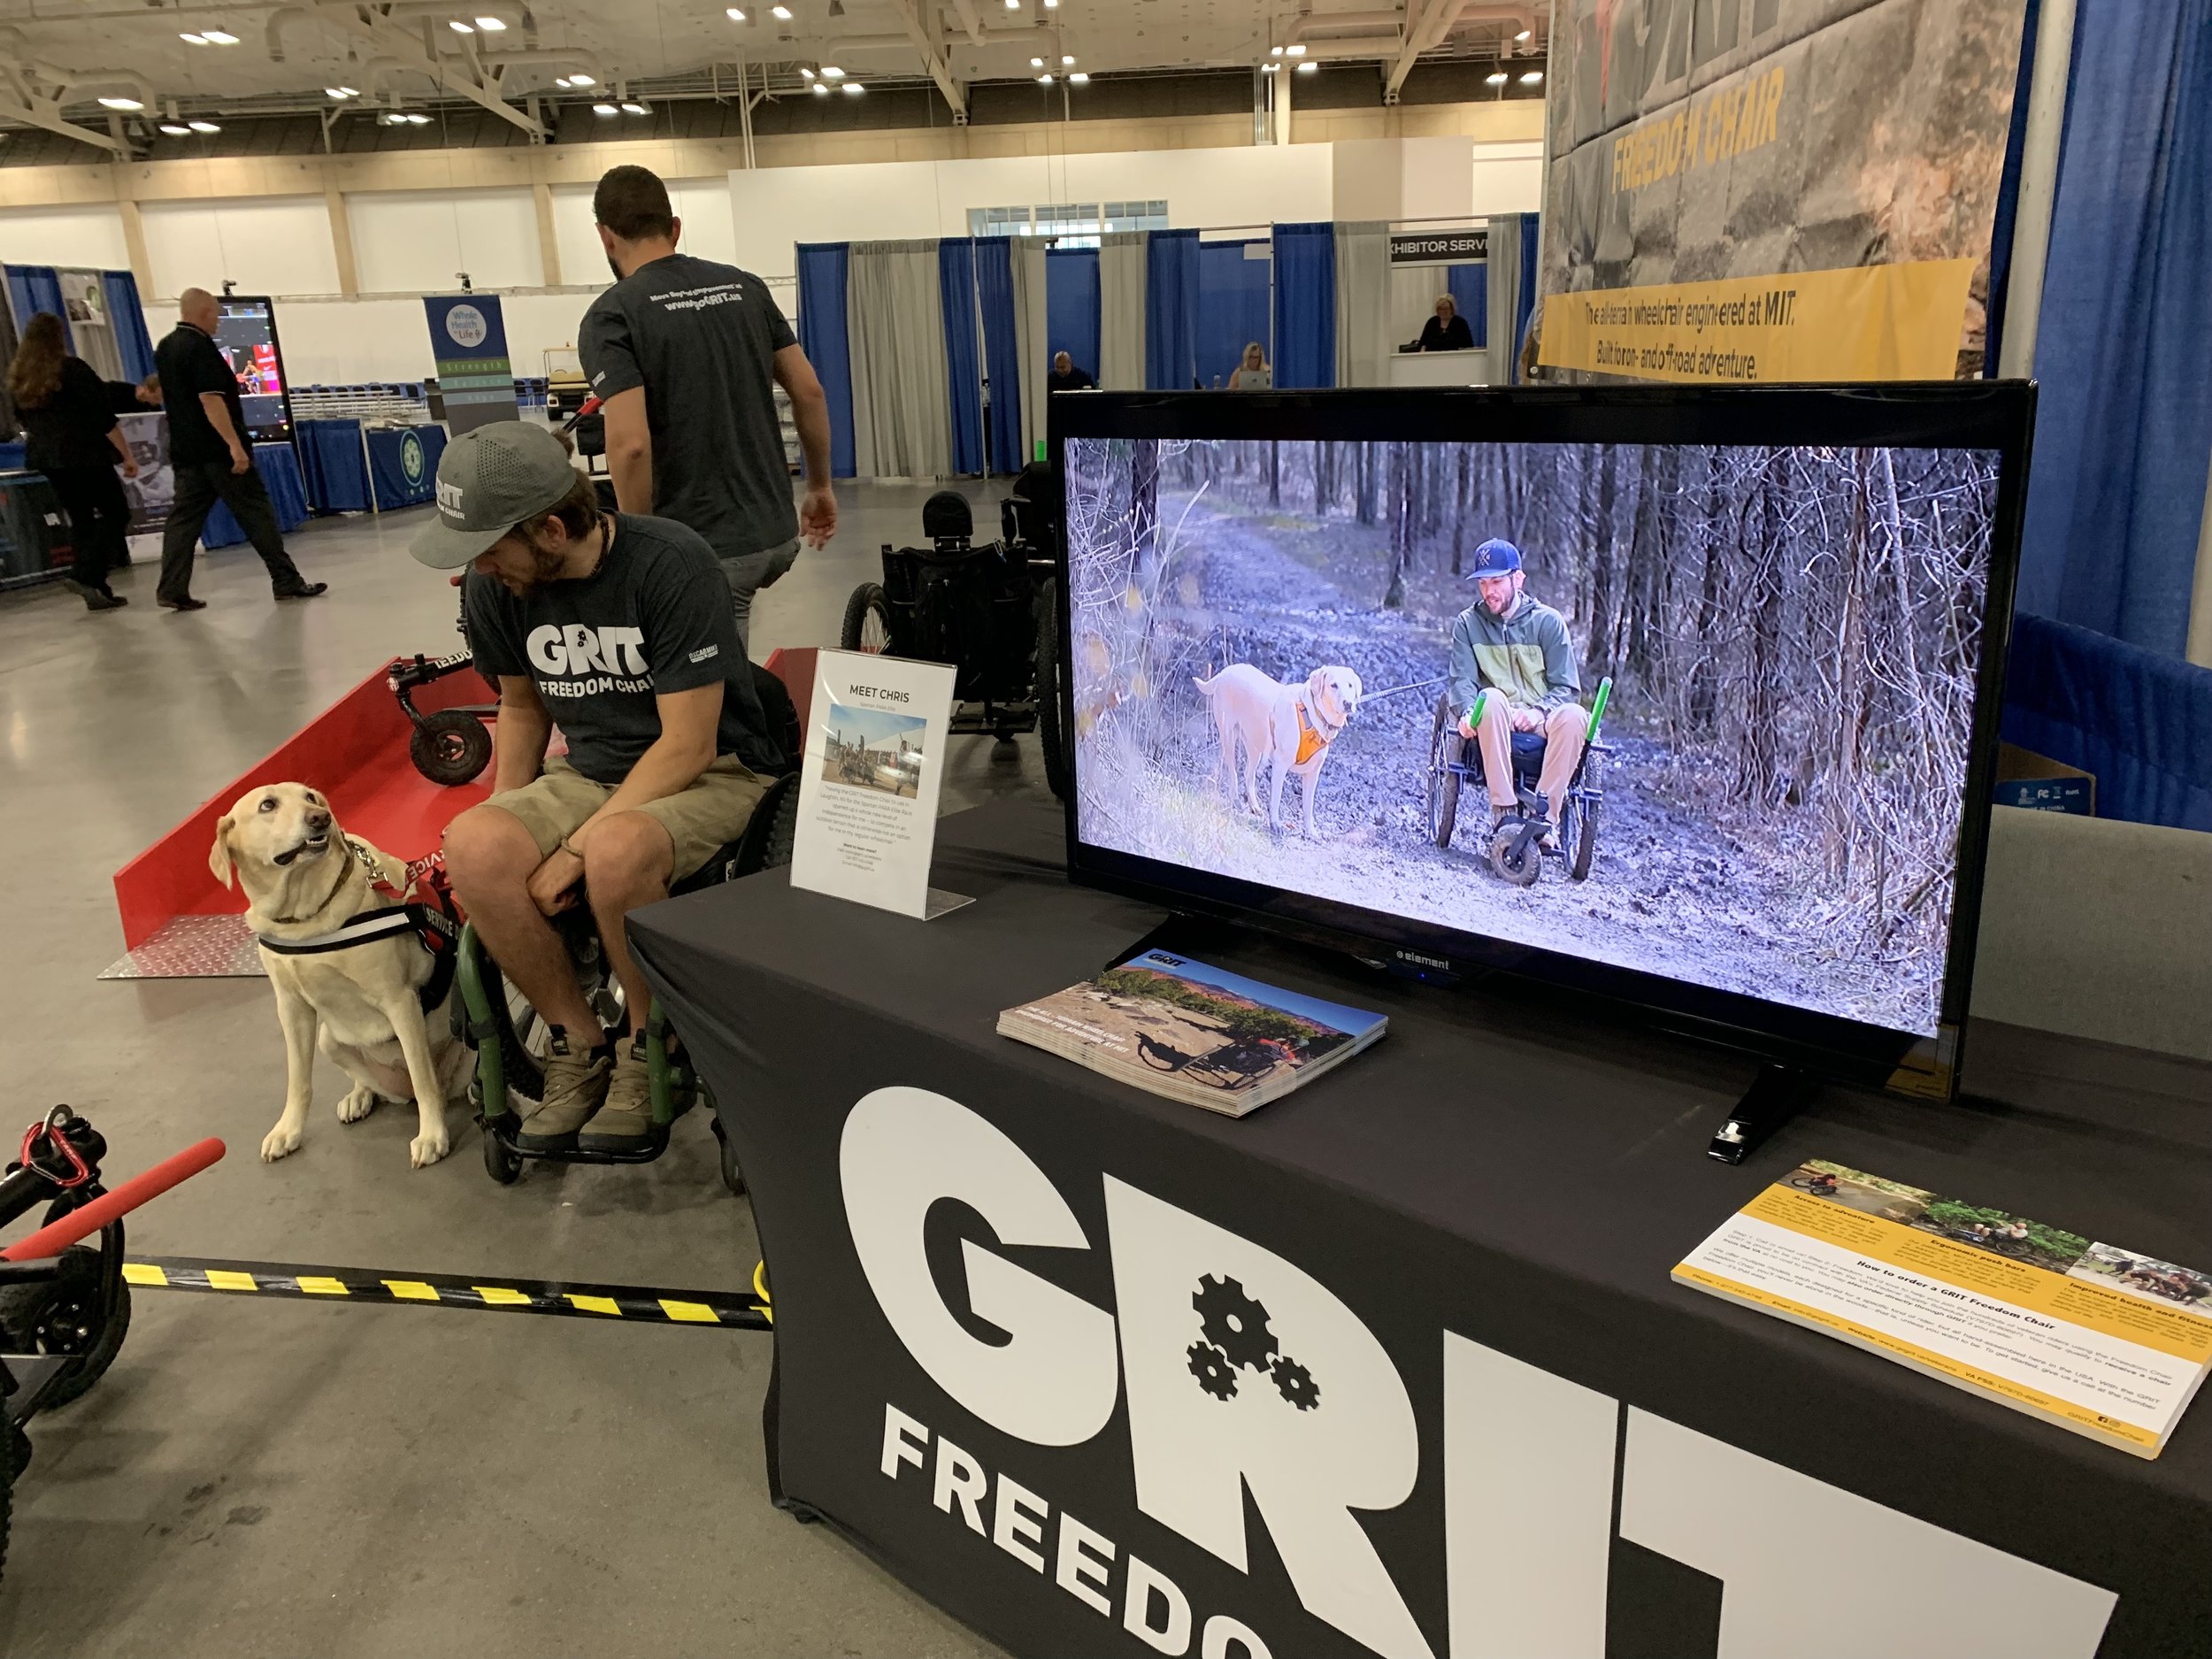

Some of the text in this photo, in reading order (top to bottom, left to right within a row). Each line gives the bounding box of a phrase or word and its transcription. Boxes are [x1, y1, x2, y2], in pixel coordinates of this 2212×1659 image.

[1612, 66, 1785, 195] FREEDOM CHAIR
[451, 319, 477, 329] Health
[452, 311, 477, 319] Whole
[1635, 297, 1684, 326] wheelchair
[1686, 293, 1747, 334] engineered
[1747, 295, 1762, 326] at
[1764, 289, 1797, 326] MIT.
[459, 330, 473, 339] Life
[446, 361, 502, 371] Strength
[1597, 340, 1613, 364] Built
[1613, 341, 1625, 365] for
[1640, 342, 1657, 369] and
[1658, 342, 1696, 373] off-road
[1699, 346, 1758, 380] adventure.
[526, 624, 649, 676] GRIT
[539, 677, 614, 698] FREEDOM
[849, 684, 910, 703] MEET CHRIS
[1148, 954, 1187, 967] GRIT
[1404, 952, 1449, 970] element
[1793, 1194, 1822, 1205] Access
[1832, 1208, 1876, 1224] adventure
[1929, 1239, 2027, 1272] Ergonomic push bars
[1855, 1261, 1882, 1271] How
[1896, 1274, 1929, 1287] order
[1939, 1287, 1968, 1301] GRIT
[1969, 1297, 2022, 1318] Freedom
[2023, 1315, 2055, 1330] Chair
[1863, 1286, 1885, 1295] order
[1883, 1293, 1914, 1306] directly
[1913, 1302, 1946, 1317] through
[1945, 1314, 1967, 1323] GRIT
[2069, 1282, 2117, 1301] Improved
[2119, 1297, 2153, 1310] health
[2154, 1309, 2175, 1317] and
[839, 1086, 2120, 1659] GRIT
